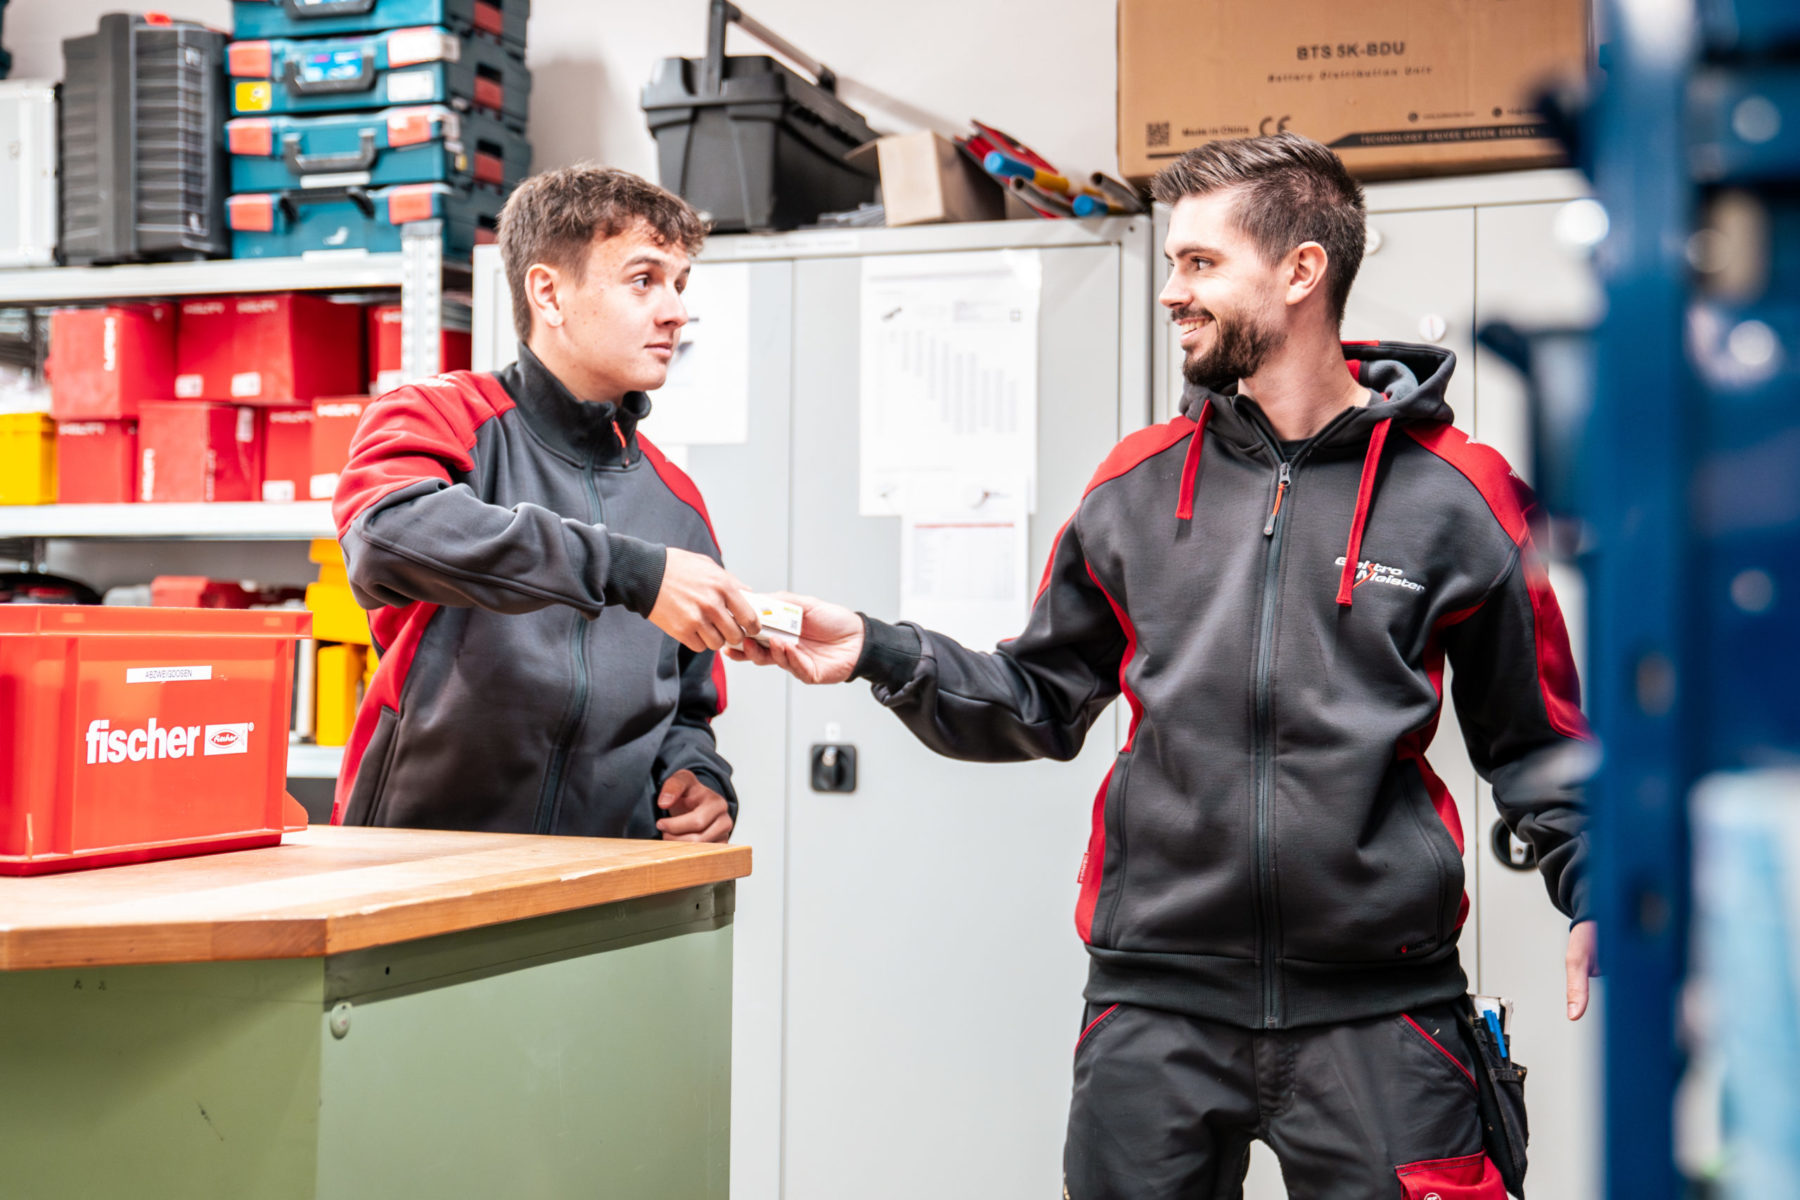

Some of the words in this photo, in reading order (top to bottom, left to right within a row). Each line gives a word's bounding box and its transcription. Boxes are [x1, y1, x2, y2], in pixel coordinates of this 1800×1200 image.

[1296, 44, 1331, 60] BTS
[1268, 72, 1314, 83] Battery
[1320, 69, 1398, 80] Distribution
[1182, 128, 1207, 137] Made
[1220, 125, 1249, 135] China
[1360, 133, 1423, 145] TECHNOLOGY
[86, 717, 201, 765] fischer
